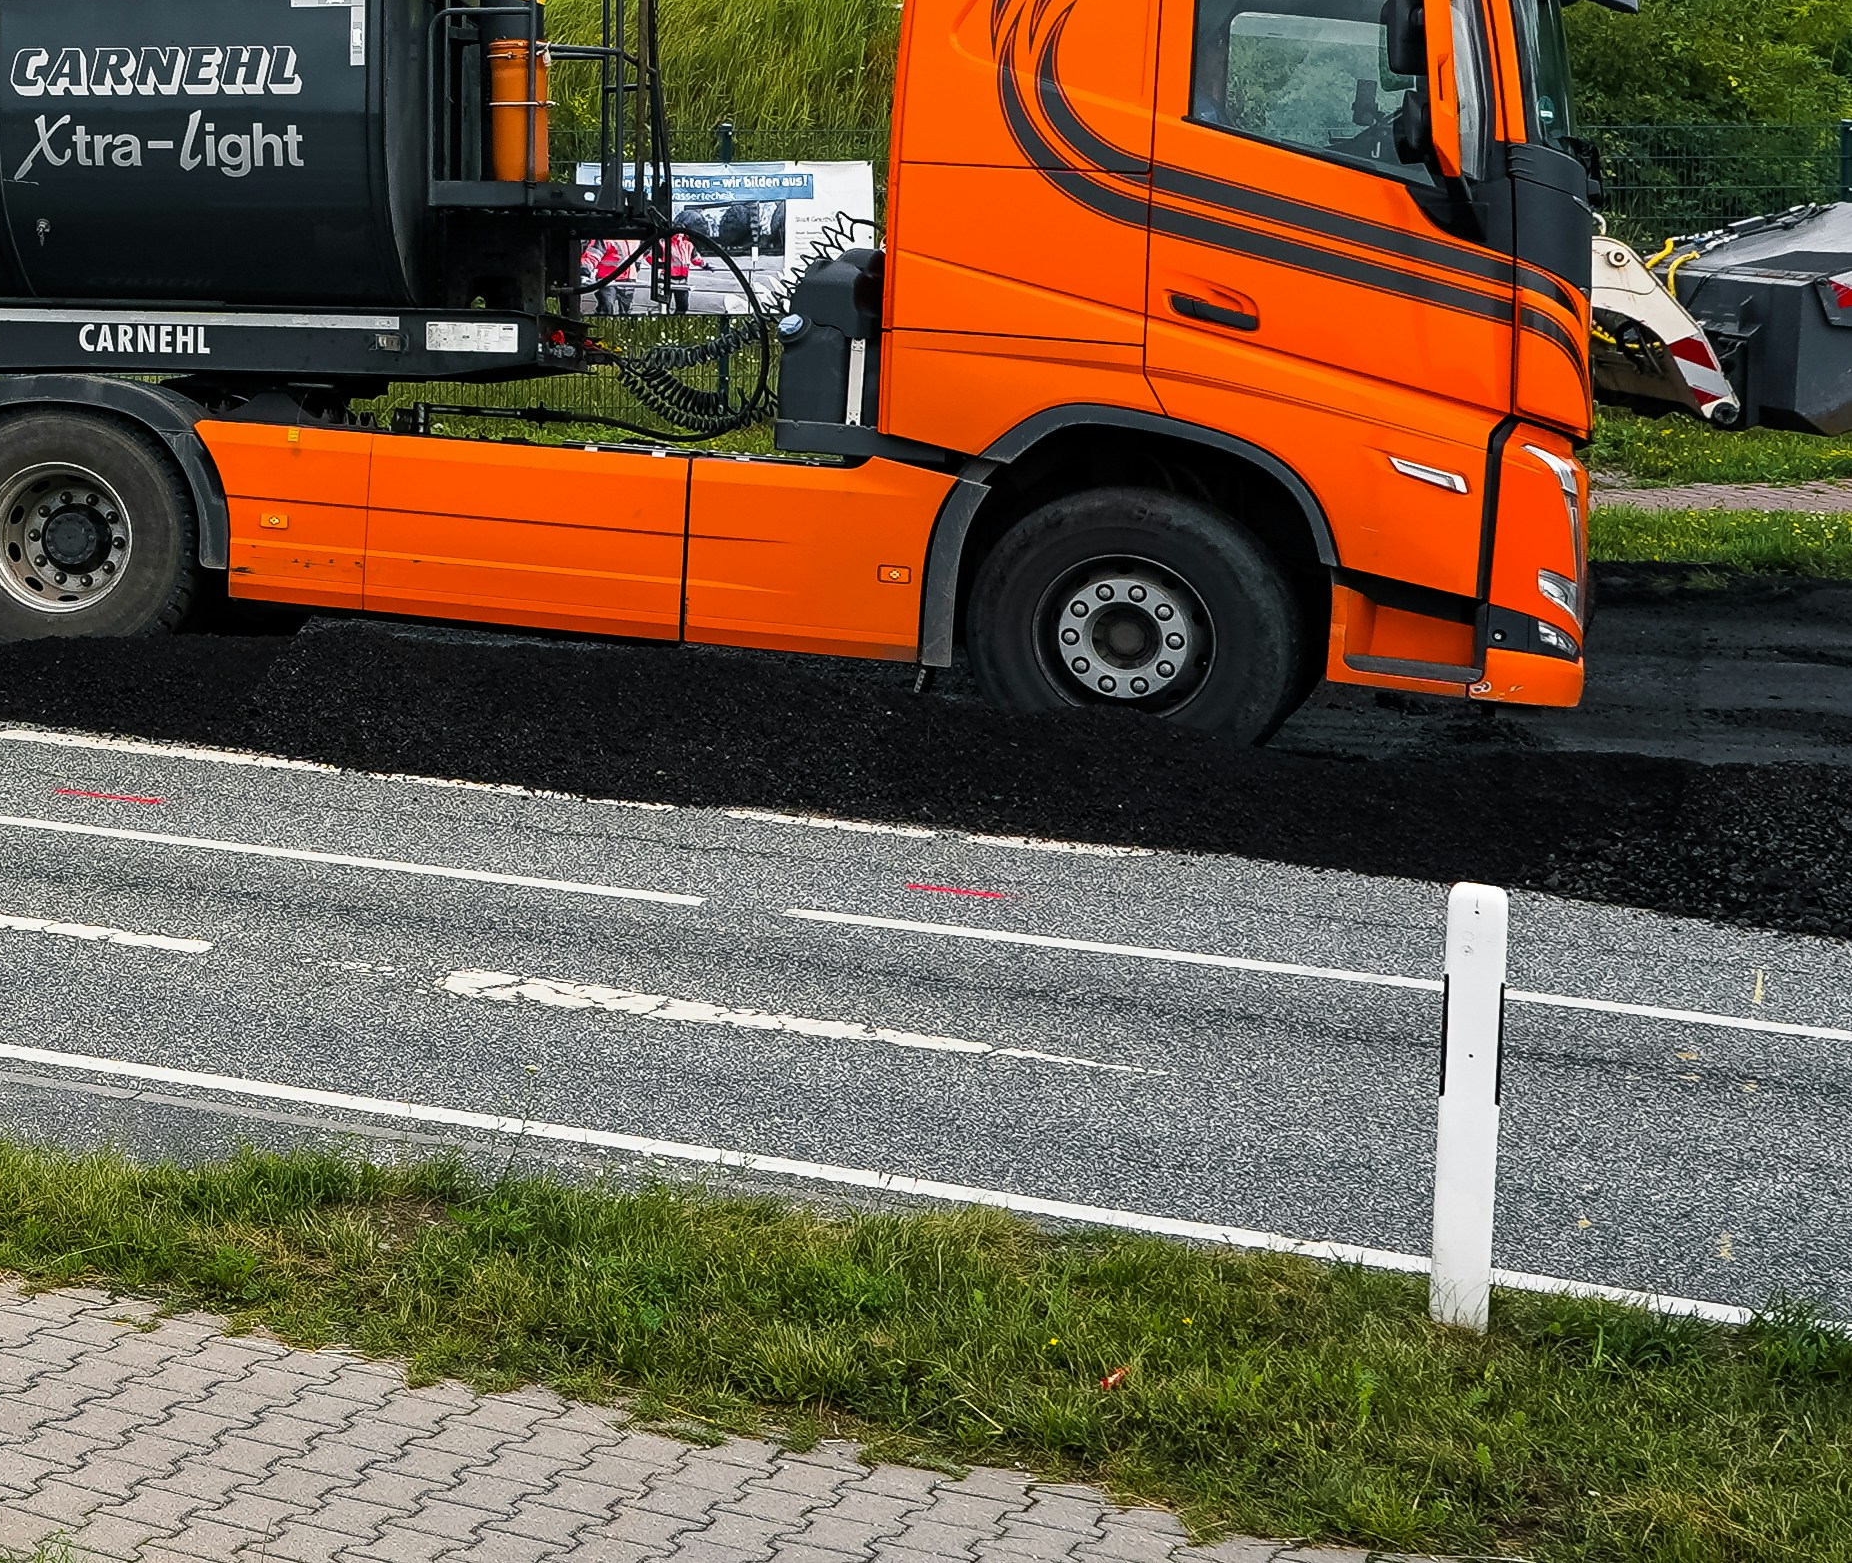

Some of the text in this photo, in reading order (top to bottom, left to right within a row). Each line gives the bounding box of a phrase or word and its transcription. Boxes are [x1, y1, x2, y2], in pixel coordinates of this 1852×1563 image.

[10, 45, 302, 96] CARNEHL
[13, 109, 306, 181] Xtra-light
[722, 176, 742, 188] wir
[743, 174, 780, 187] bilden
[782, 174, 808, 187] aus!
[78, 323, 211, 355] CARNEHL
